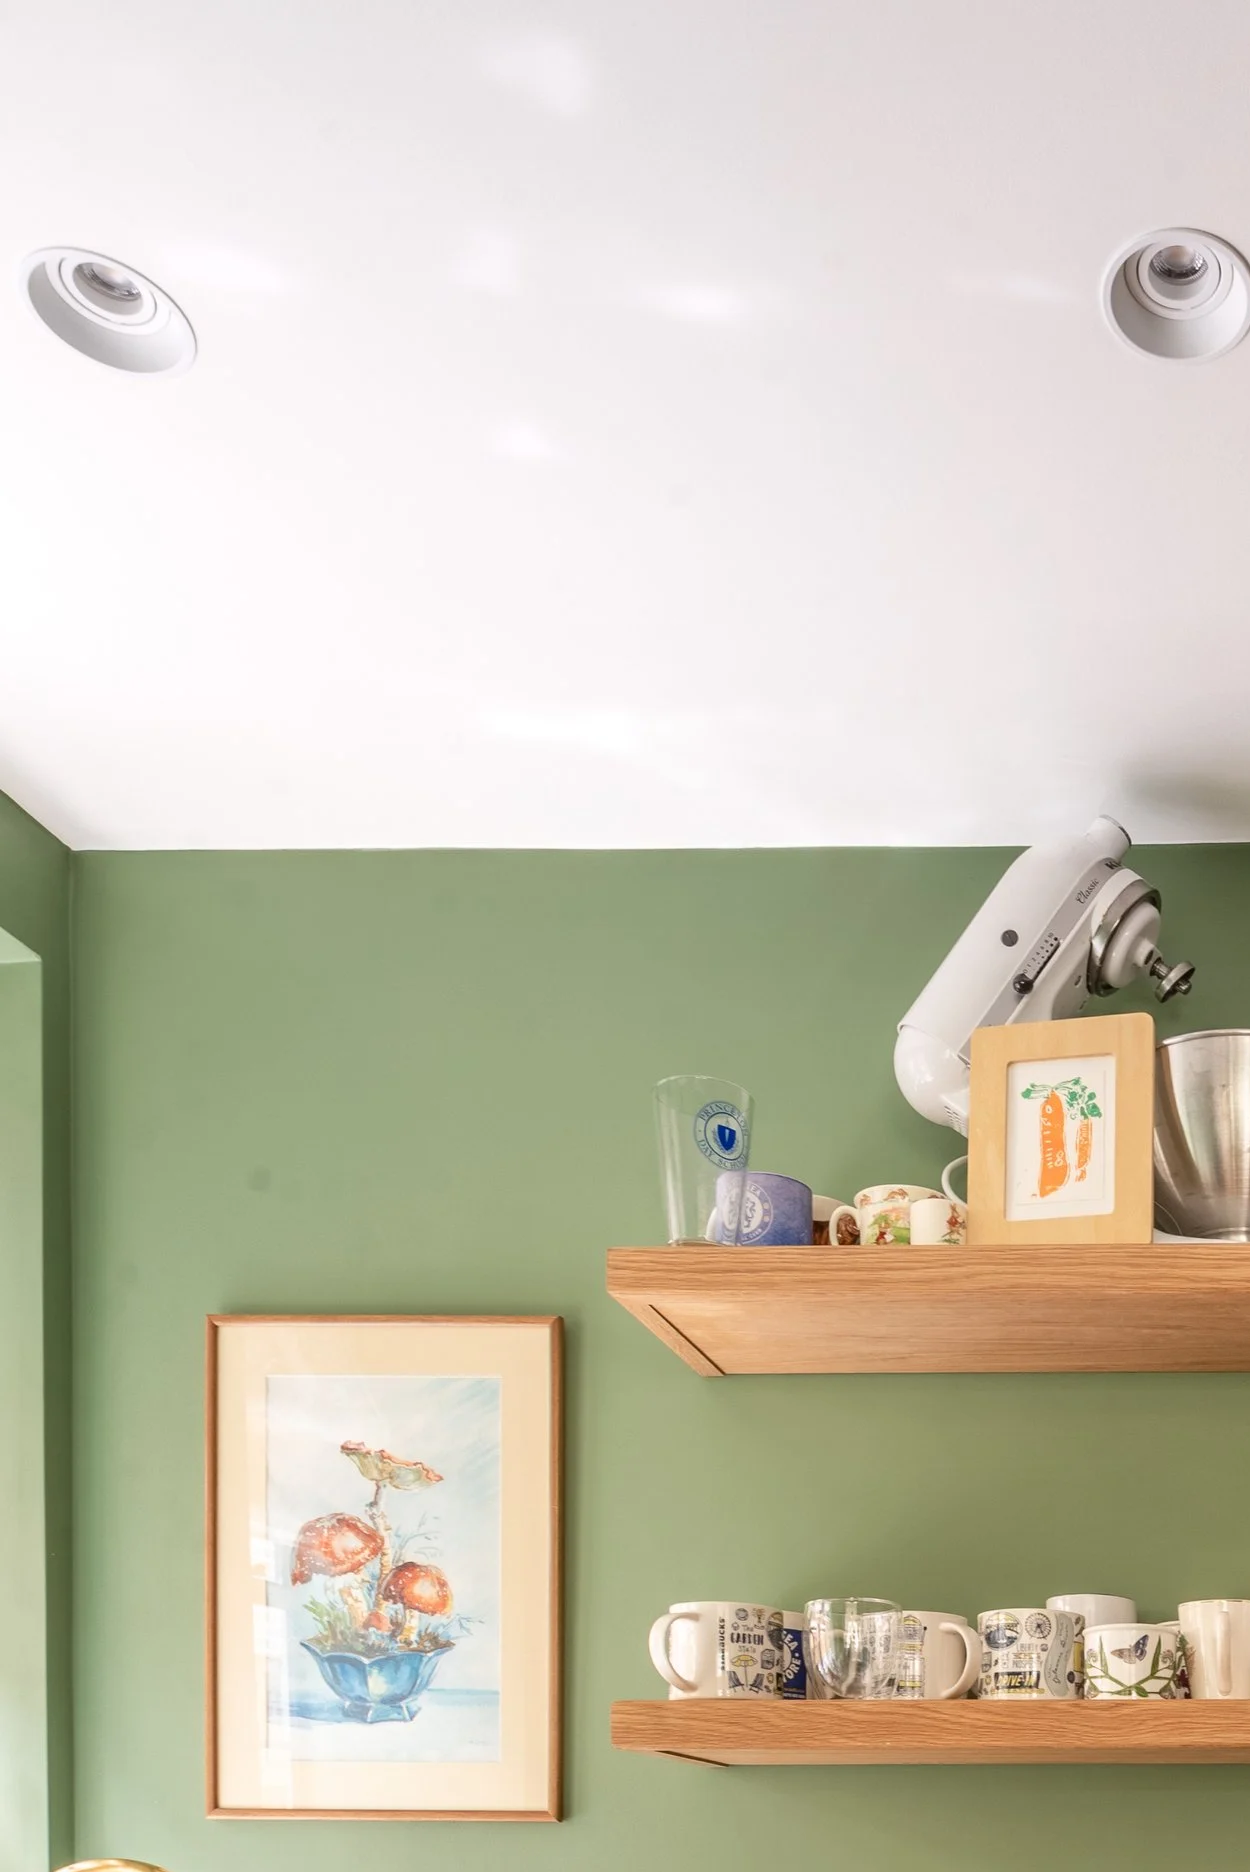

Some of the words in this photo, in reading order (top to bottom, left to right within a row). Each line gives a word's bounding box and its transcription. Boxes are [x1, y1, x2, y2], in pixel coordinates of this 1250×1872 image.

[1075, 878, 1100, 904] Classic
[698, 1139, 714, 1158] DAY
[731, 1634, 764, 1646] GARDEN
